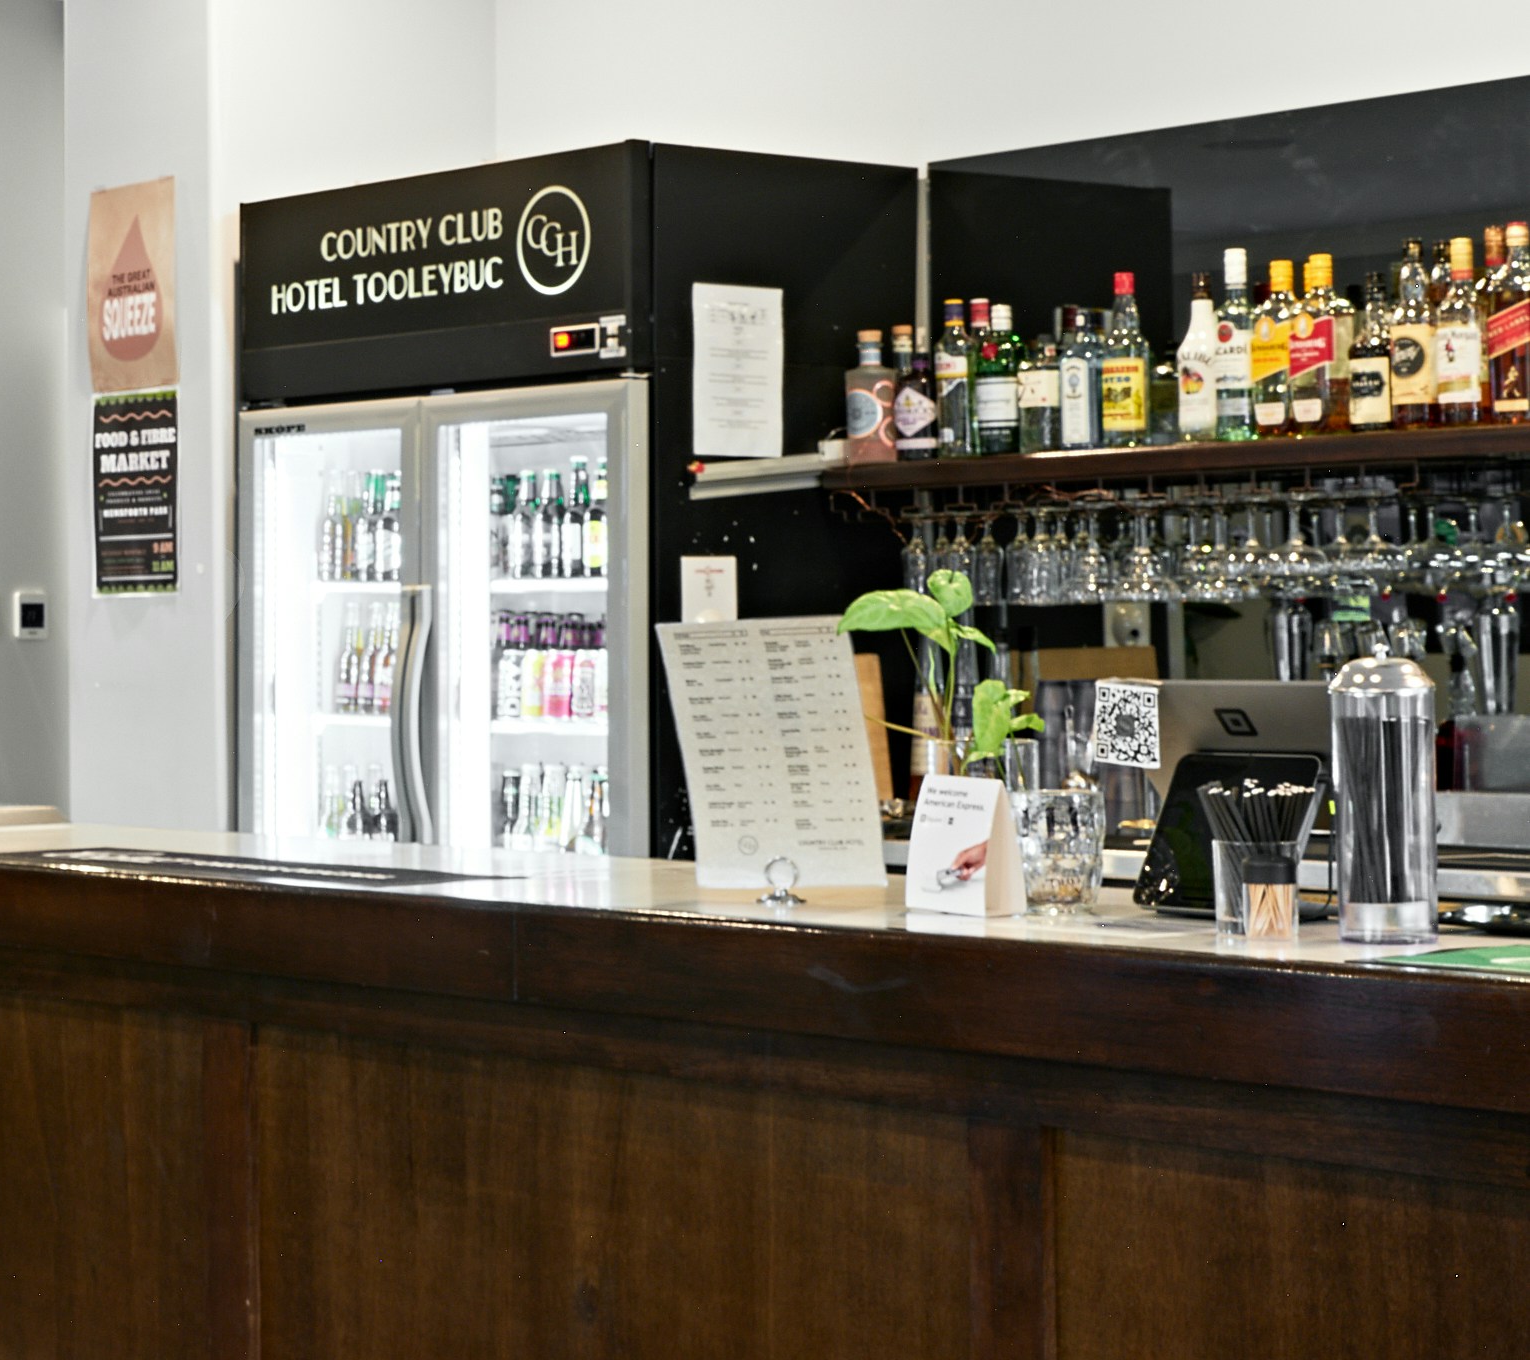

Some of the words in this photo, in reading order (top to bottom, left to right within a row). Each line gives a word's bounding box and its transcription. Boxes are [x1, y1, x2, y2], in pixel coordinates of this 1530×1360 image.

[320, 217, 432, 262] COUNTRY
[438, 207, 503, 246] CLUB
[526, 214, 579, 267] CCH
[112, 272, 125, 285] THE
[128, 268, 150, 283] GREAT
[271, 276, 347, 314] HOTEL
[353, 256, 504, 305] TOOLEYBUC
[107, 281, 155, 297] AUSTRALIAN
[102, 292, 156, 341] SQUEEZE
[95, 431, 129, 449] FOOD
[140, 426, 176, 445] FIBRE
[254, 424, 306, 436] SKOPE
[100, 449, 170, 474] MARKET
[924, 799, 956, 808] American
[939, 788, 968, 797] welcome
